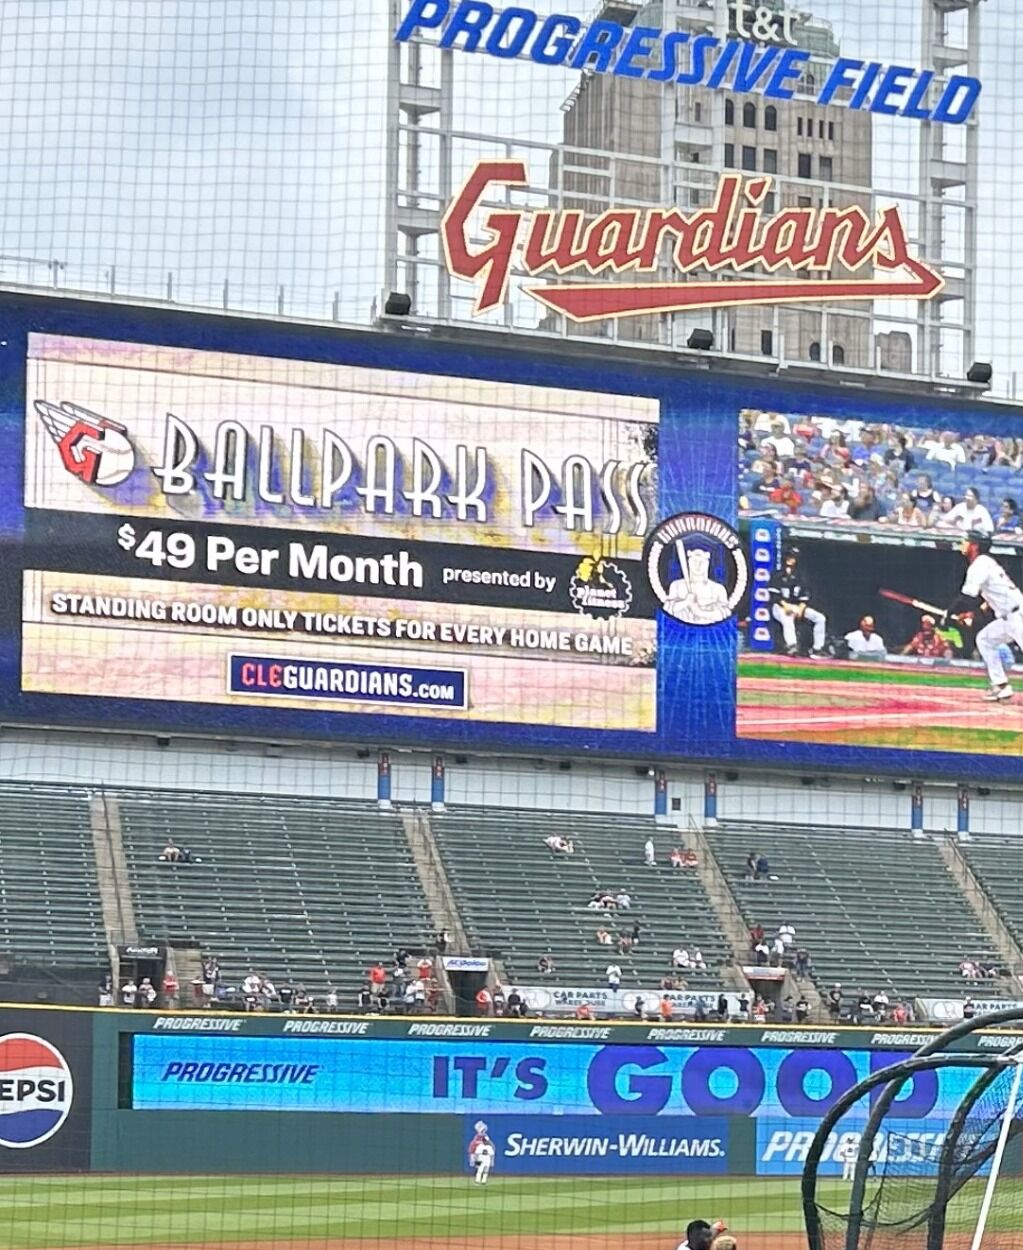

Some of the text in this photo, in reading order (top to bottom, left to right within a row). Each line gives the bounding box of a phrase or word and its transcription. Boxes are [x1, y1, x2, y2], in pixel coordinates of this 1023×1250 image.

[394, 0, 982, 124] PROGRESSIVE FIELD
[442, 158, 928, 317] Guardians
[151, 412, 652, 536] BALLPARK PASS
[117, 523, 424, 588] $49 Per Month
[443, 567, 556, 592] presented by
[52, 593, 633, 655] STANDING ROOM ONLY TICKETS FOR EVERY HOME GAME
[153, 1017, 243, 1031] PROGRESSIVE
[283, 1020, 370, 1034] PROGRESSIVE
[408, 1023, 492, 1037] PROGRESSIVE
[530, 1026, 611, 1039] PROGRESSIVE
[647, 1028, 725, 1041] PROGRESSIVE
[761, 1031, 837, 1044] PROGRESSIVE
[162, 1062, 318, 1084] PROGRESSIVE
[433, 1044, 939, 1118] IT'S GOOD
[0, 1079, 65, 1102] EPSI
